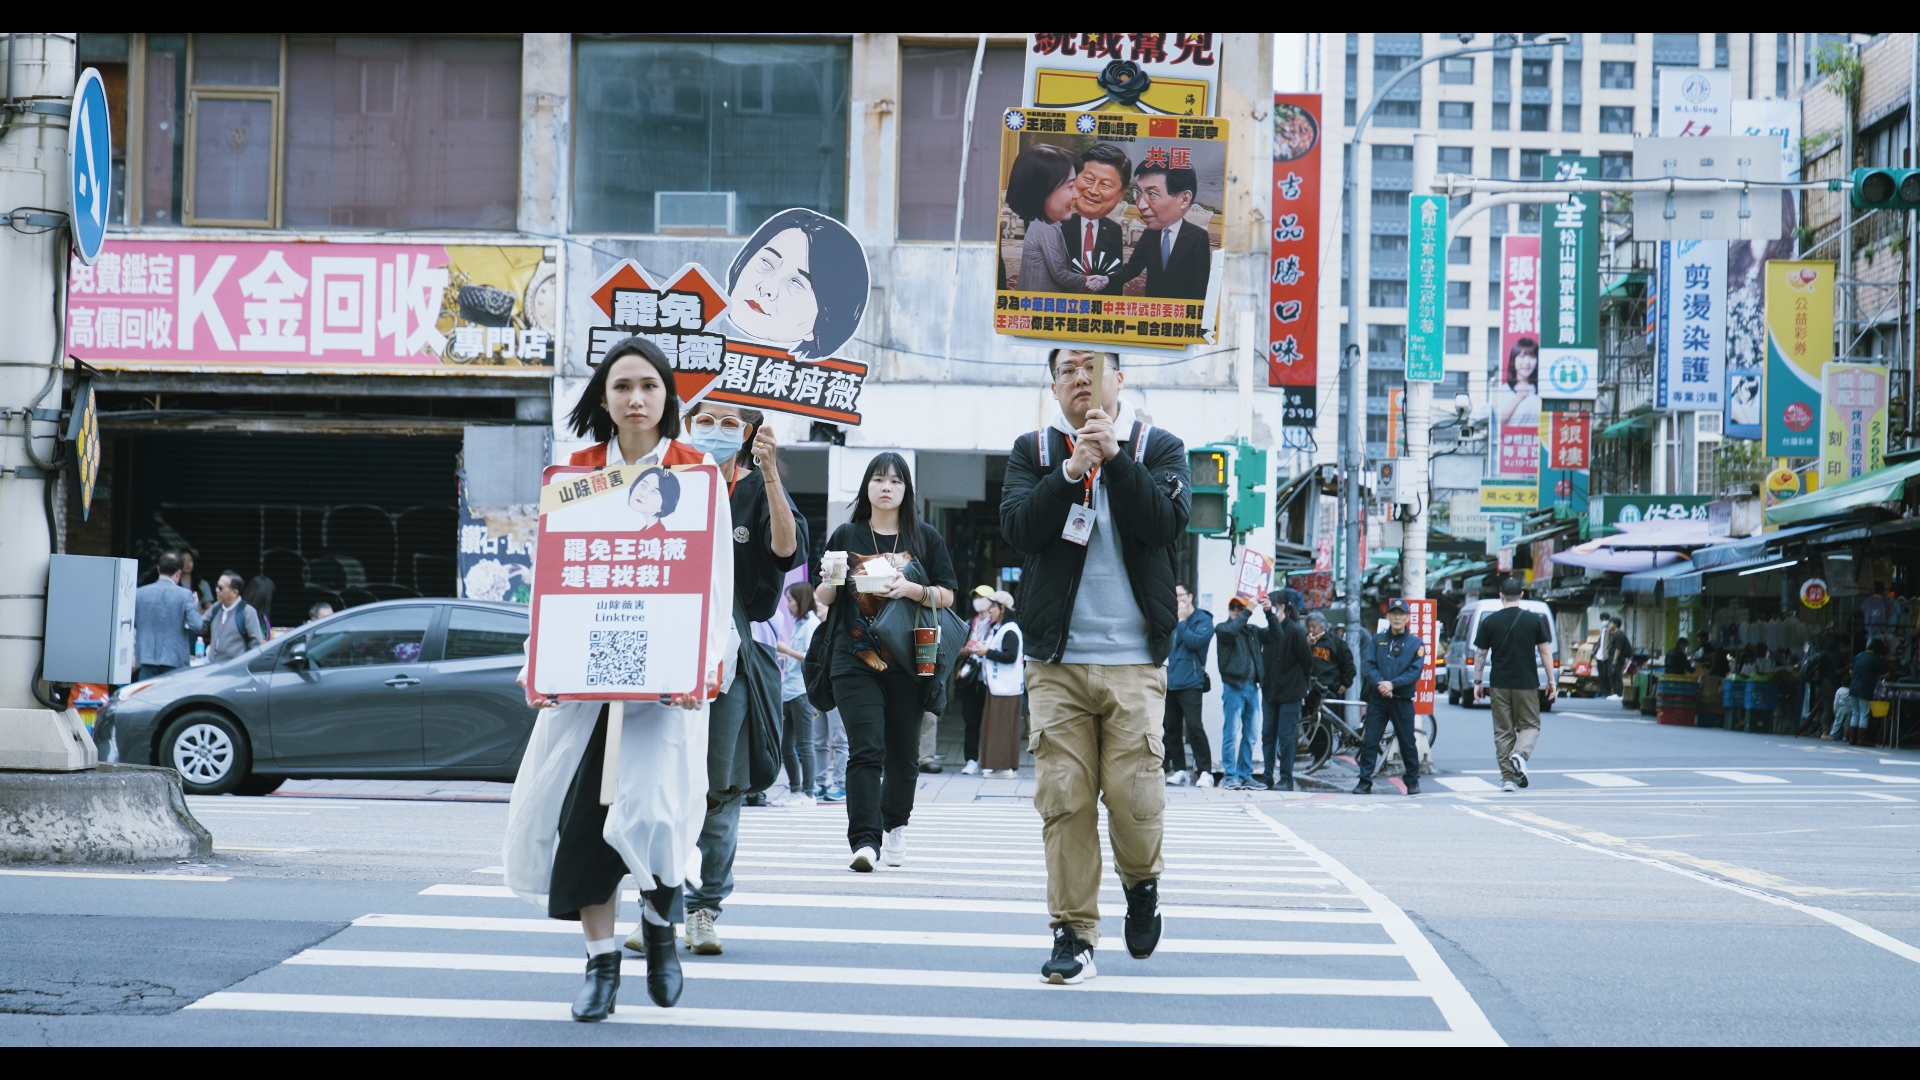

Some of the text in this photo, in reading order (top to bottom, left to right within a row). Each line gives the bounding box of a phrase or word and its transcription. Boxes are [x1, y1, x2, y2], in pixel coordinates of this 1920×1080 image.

[1026, 118, 1067, 132] 王鴻薇
[1144, 146, 1192, 170] 共匪
[70, 252, 173, 295] 免費鑑定
[1271, 171, 1305, 366] 吉品勝口味
[1558, 228, 1577, 345] 松山南京東藥局
[177, 250, 450, 357] K金回收
[614, 290, 702, 329] 罷免
[1508, 255, 1534, 334] 張文潔
[69, 306, 173, 349] 高價回收
[454, 326, 548, 360] 專門店
[1682, 263, 1712, 384] 剪燙染護
[1793, 296, 1809, 356] 公益彩券
[1672, 391, 1719, 403] 專業沙龍
[1828, 430, 1843, 476] 刻印
[558, 469, 625, 504] 山除薇害
[563, 538, 687, 562] 罷免王鴻薇
[561, 564, 671, 589] 連署找我!
[594, 612, 646, 622] Linktree
[596, 600, 645, 611] 山除薇害
